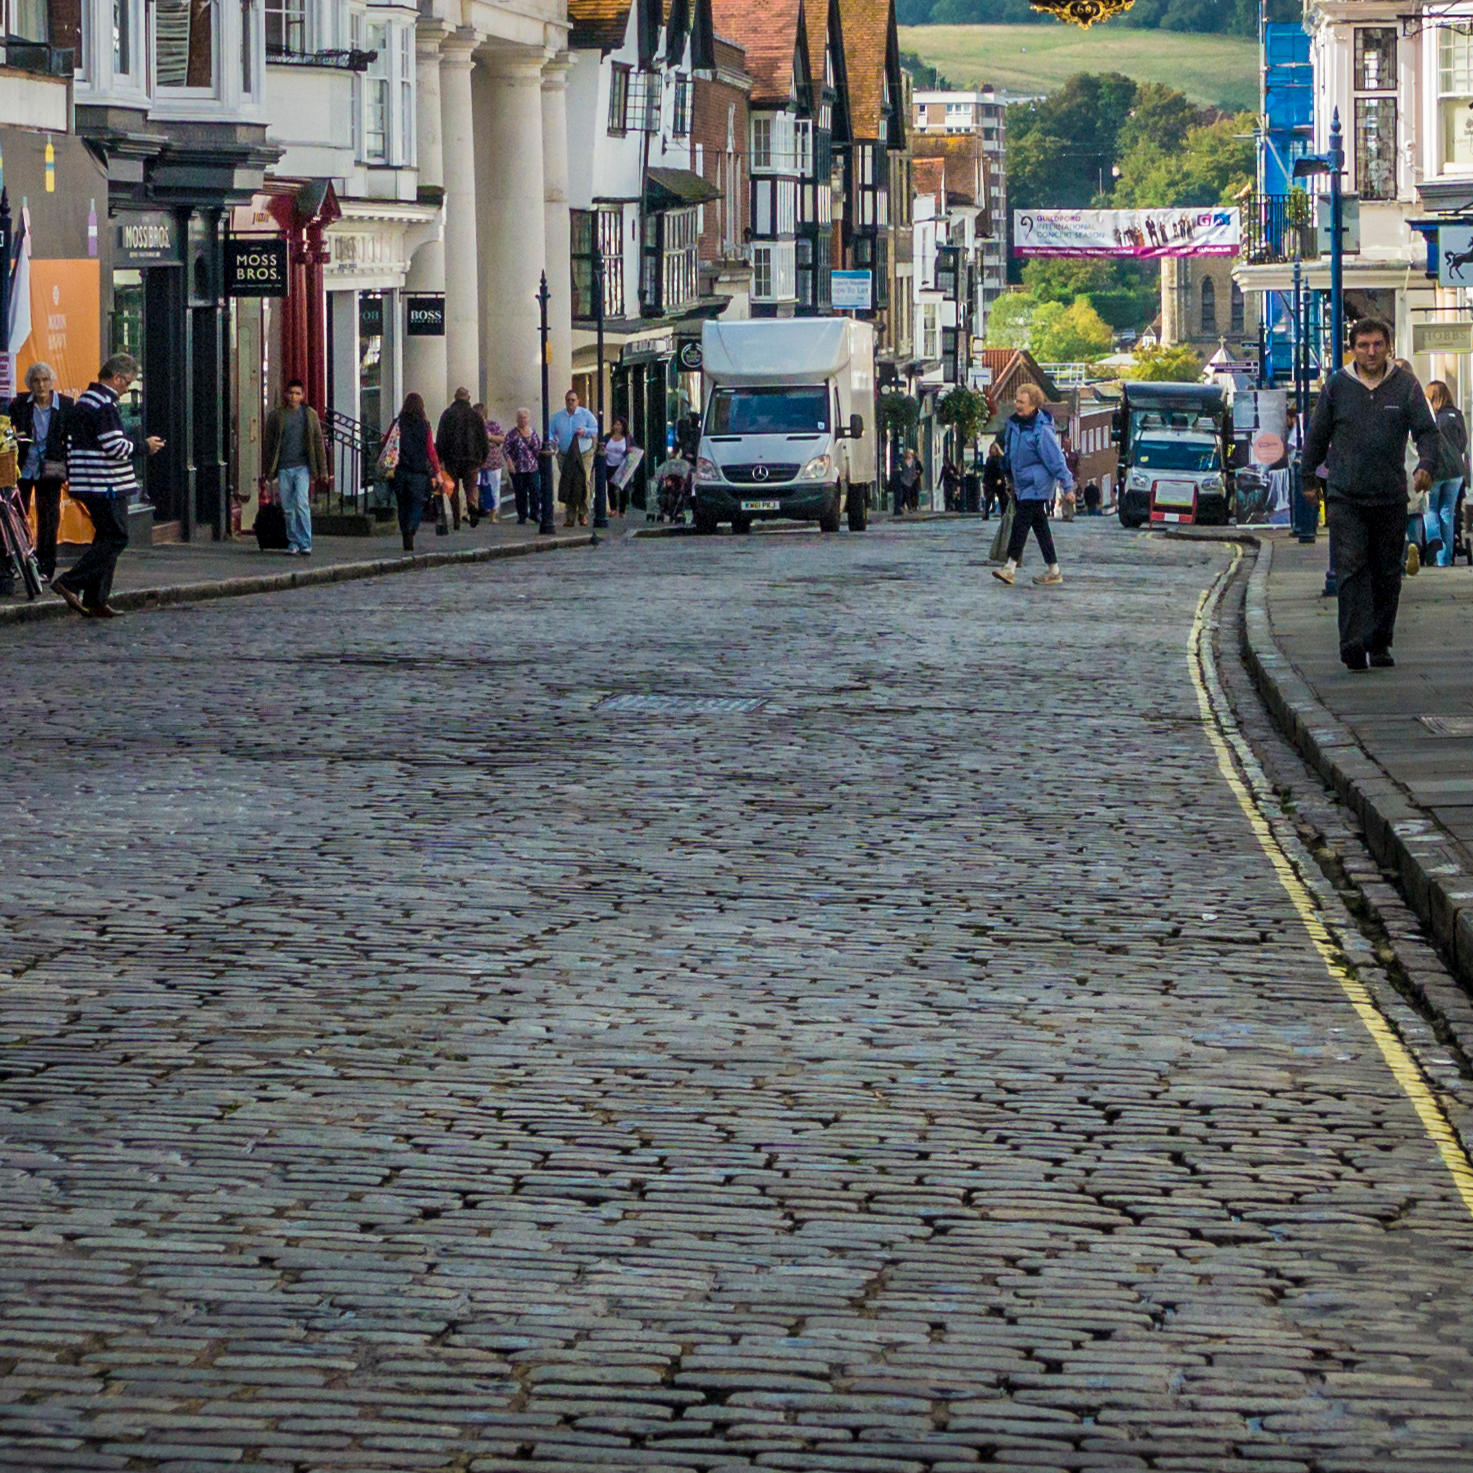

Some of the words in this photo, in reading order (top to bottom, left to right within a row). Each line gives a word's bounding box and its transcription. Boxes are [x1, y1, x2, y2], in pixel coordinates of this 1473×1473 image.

[125, 226, 148, 249] MOSS
[148, 226, 171, 249] BROS.
[236, 254, 277, 266] MOSS
[236, 268, 281, 280] BROS.
[410, 310, 442, 320] BOSS
